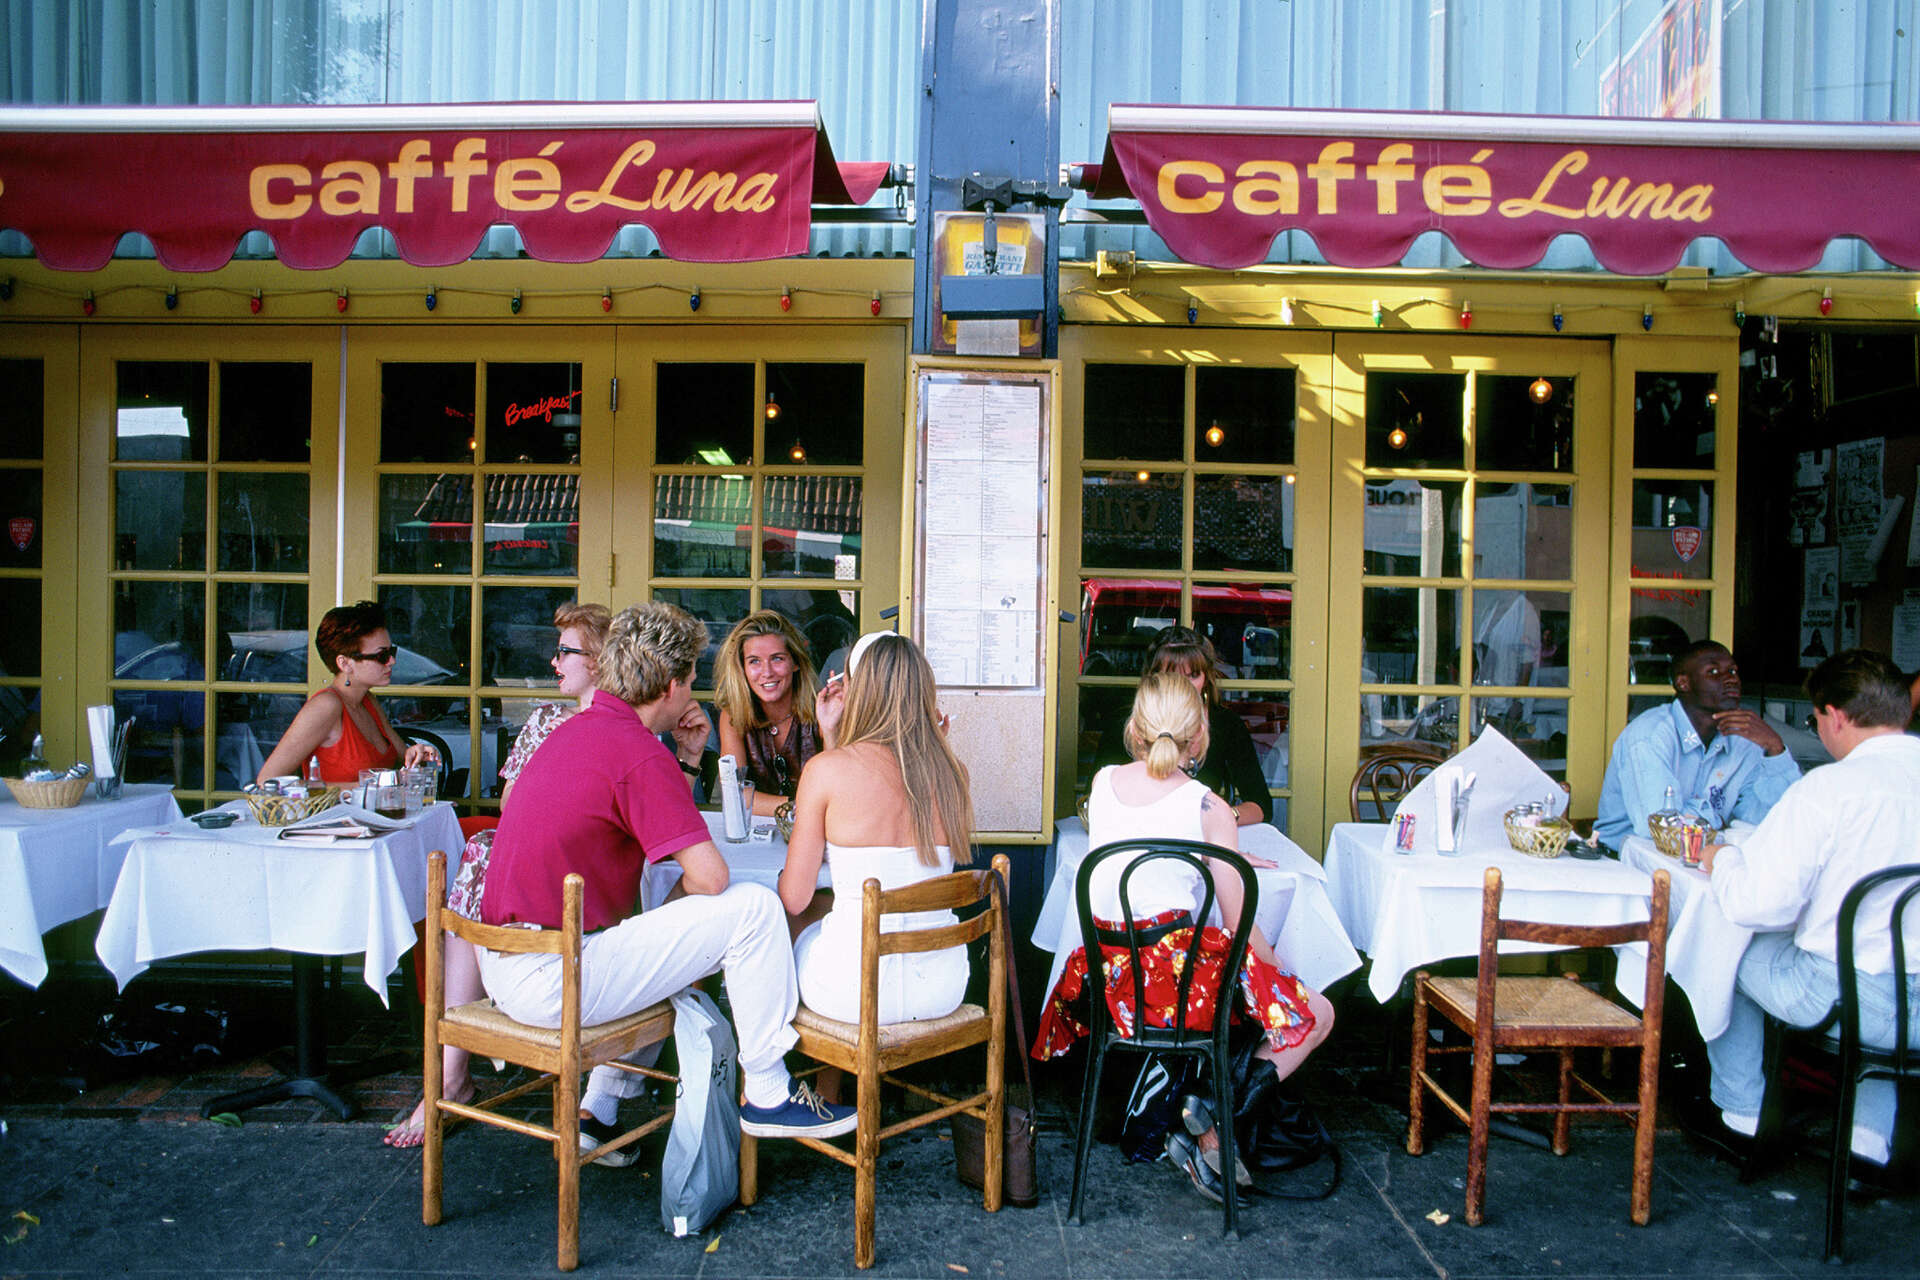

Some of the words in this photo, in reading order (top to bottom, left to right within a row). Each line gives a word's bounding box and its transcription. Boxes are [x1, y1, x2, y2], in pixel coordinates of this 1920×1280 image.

[250, 138, 563, 220] caffé
[566, 140, 778, 214] Luna
[1158, 141, 1494, 216] caffé
[1498, 150, 1713, 222] Luna
[967, 253, 1023, 264] RESRANT
